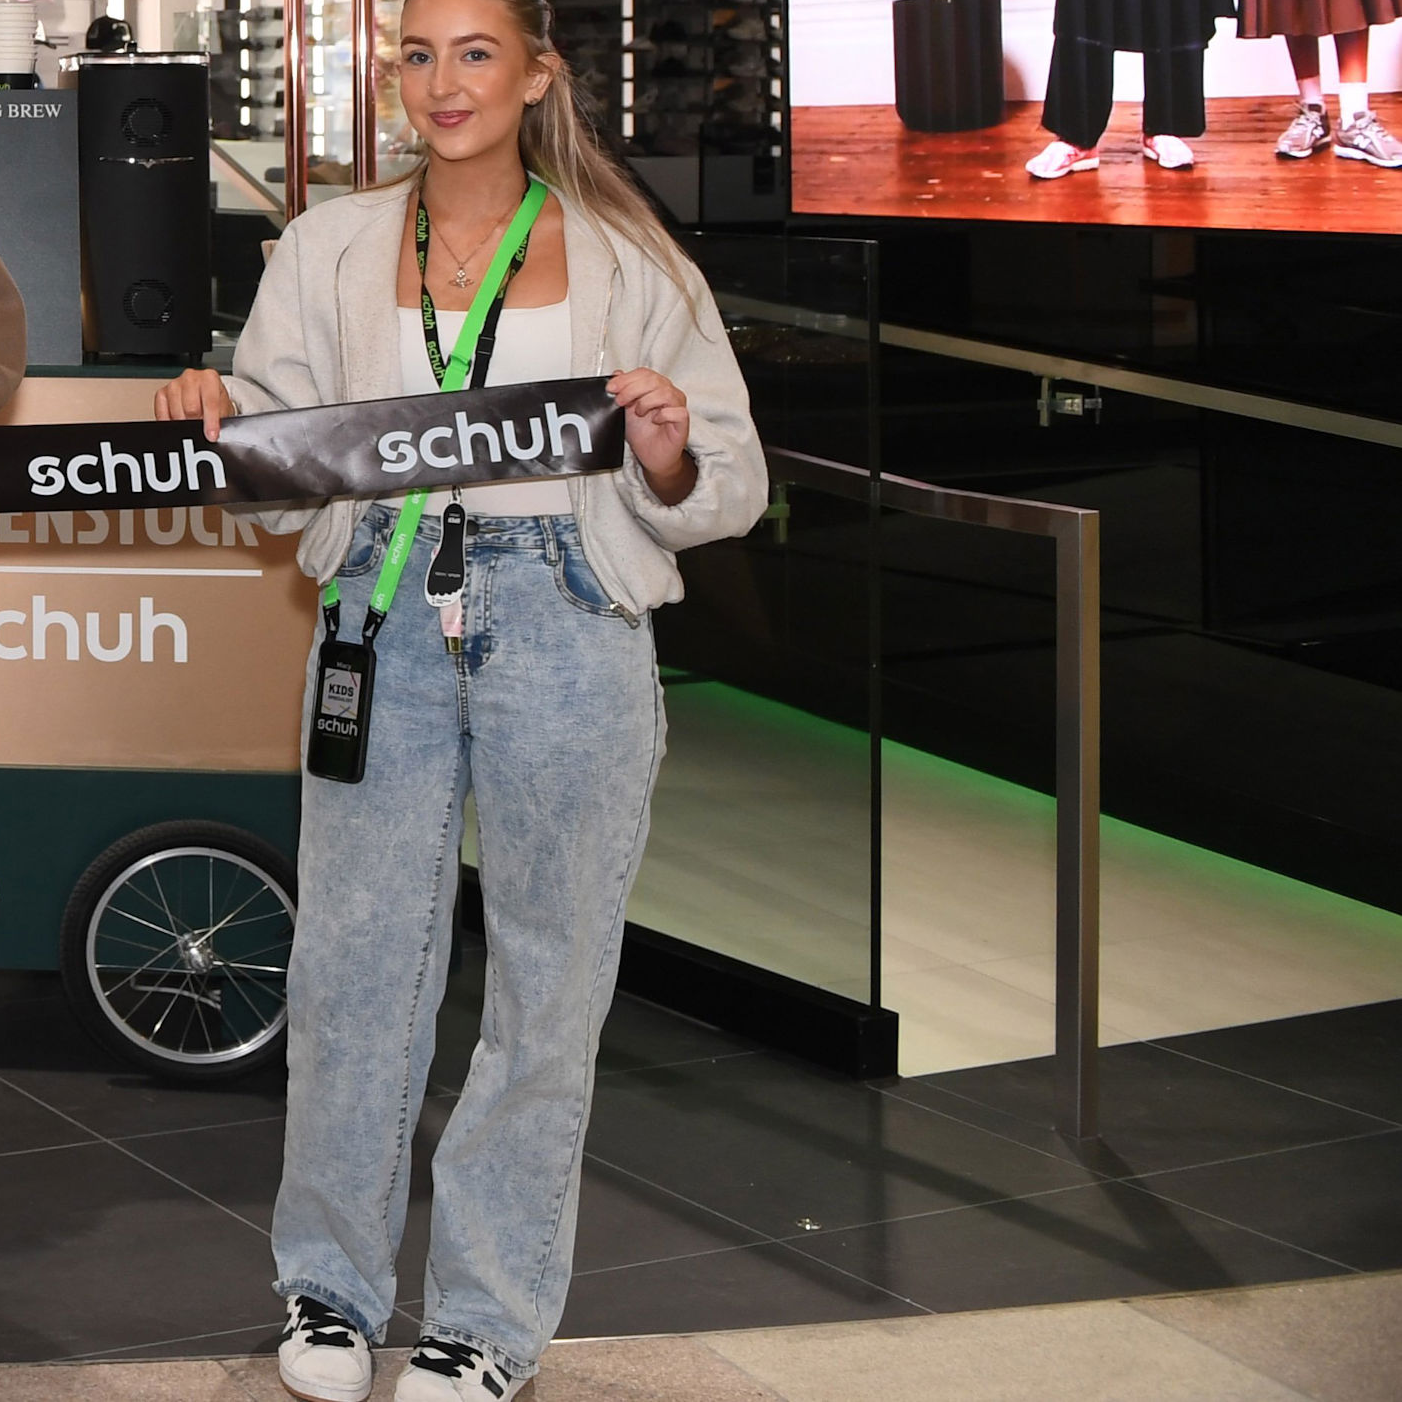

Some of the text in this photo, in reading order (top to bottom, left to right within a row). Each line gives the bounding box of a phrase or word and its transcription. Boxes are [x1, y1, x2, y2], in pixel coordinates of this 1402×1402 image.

[7, 103, 63, 119] BREW
[417, 208, 429, 243] schuh
[422, 294, 434, 330] schuh
[427, 340, 445, 380] schuh
[377, 401, 593, 474] schuh
[27, 438, 227, 497] schuh
[391, 533, 408, 565] schuh
[328, 683, 355, 697] KIDS
[317, 717, 359, 736] schuh
